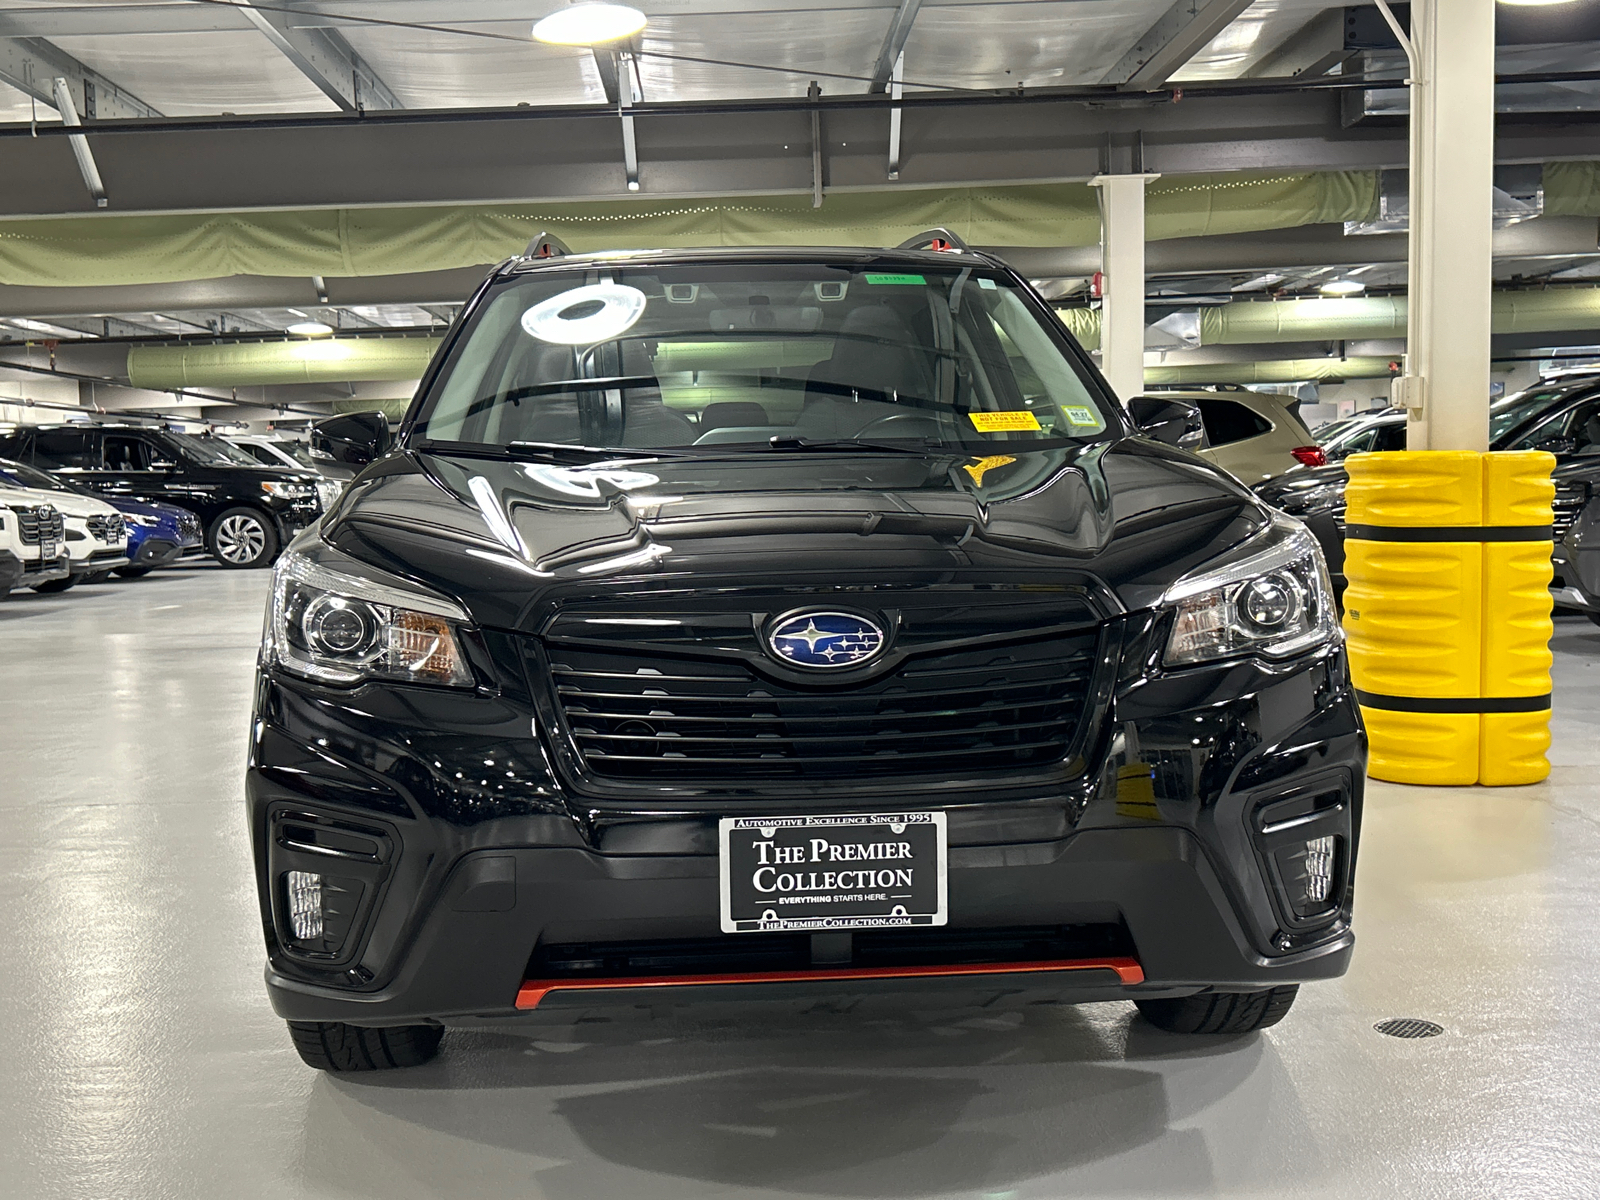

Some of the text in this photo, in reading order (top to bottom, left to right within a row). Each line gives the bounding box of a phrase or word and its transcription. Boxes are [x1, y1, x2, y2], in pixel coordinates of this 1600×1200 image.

[736, 814, 930, 828] AUTOMOTIVE EXCELLENCE SINCE 1995
[752, 838, 913, 865] THE PREMIER
[752, 866, 913, 893] COLLECTION
[778, 893, 888, 905] EVERYTHING STARTS HERE.
